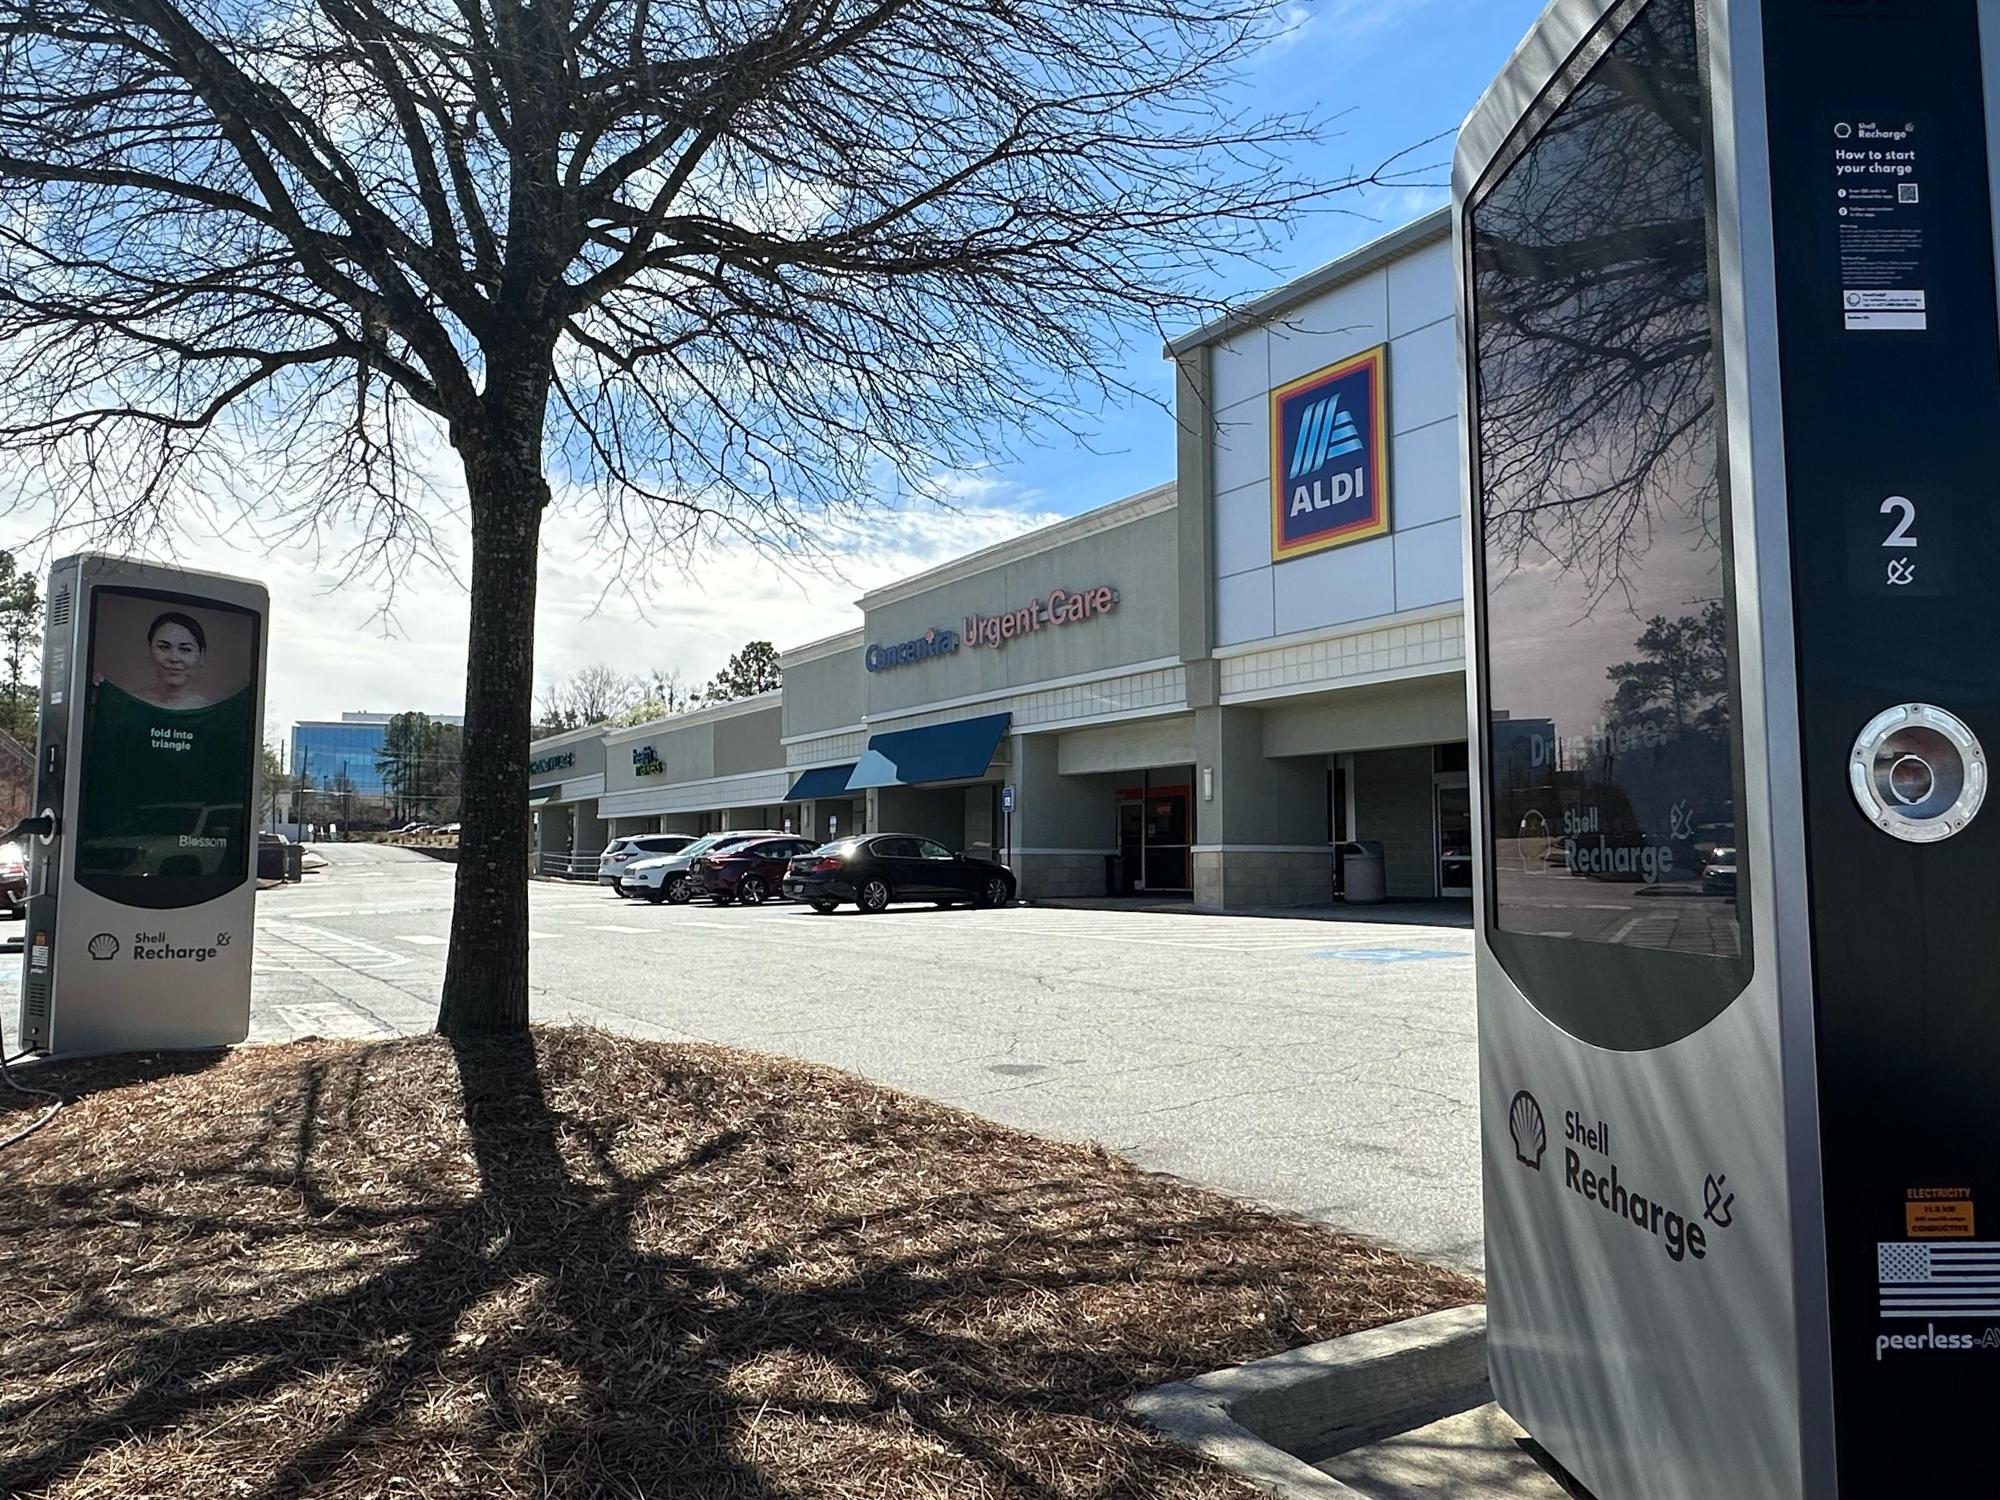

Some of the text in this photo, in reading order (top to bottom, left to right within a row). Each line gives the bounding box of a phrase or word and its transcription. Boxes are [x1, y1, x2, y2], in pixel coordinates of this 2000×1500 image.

[1858, 130, 1907, 141] Recharge
[1836, 149, 1916, 161] How to start
[1836, 162, 1913, 176] your charge
[1290, 467, 1364, 517] ALDI
[1879, 496, 1918, 547] 2
[962, 599, 1040, 649] Urgent
[1047, 585, 1113, 626] Care
[150, 728, 194, 740] fold into
[152, 739, 191, 751] triangle
[1564, 807, 1599, 834] Shell
[179, 835, 227, 848] Blossom
[1565, 835, 1673, 883] Recharge
[135, 932, 166, 943] Shell
[134, 944, 217, 962] Recharge
[1565, 1110, 1609, 1157] Shell
[1907, 1187, 1971, 1199] ELECTRICITY
[1565, 1147, 1706, 1262] Recharge
[1876, 1323, 2000, 1361] peerless-A
